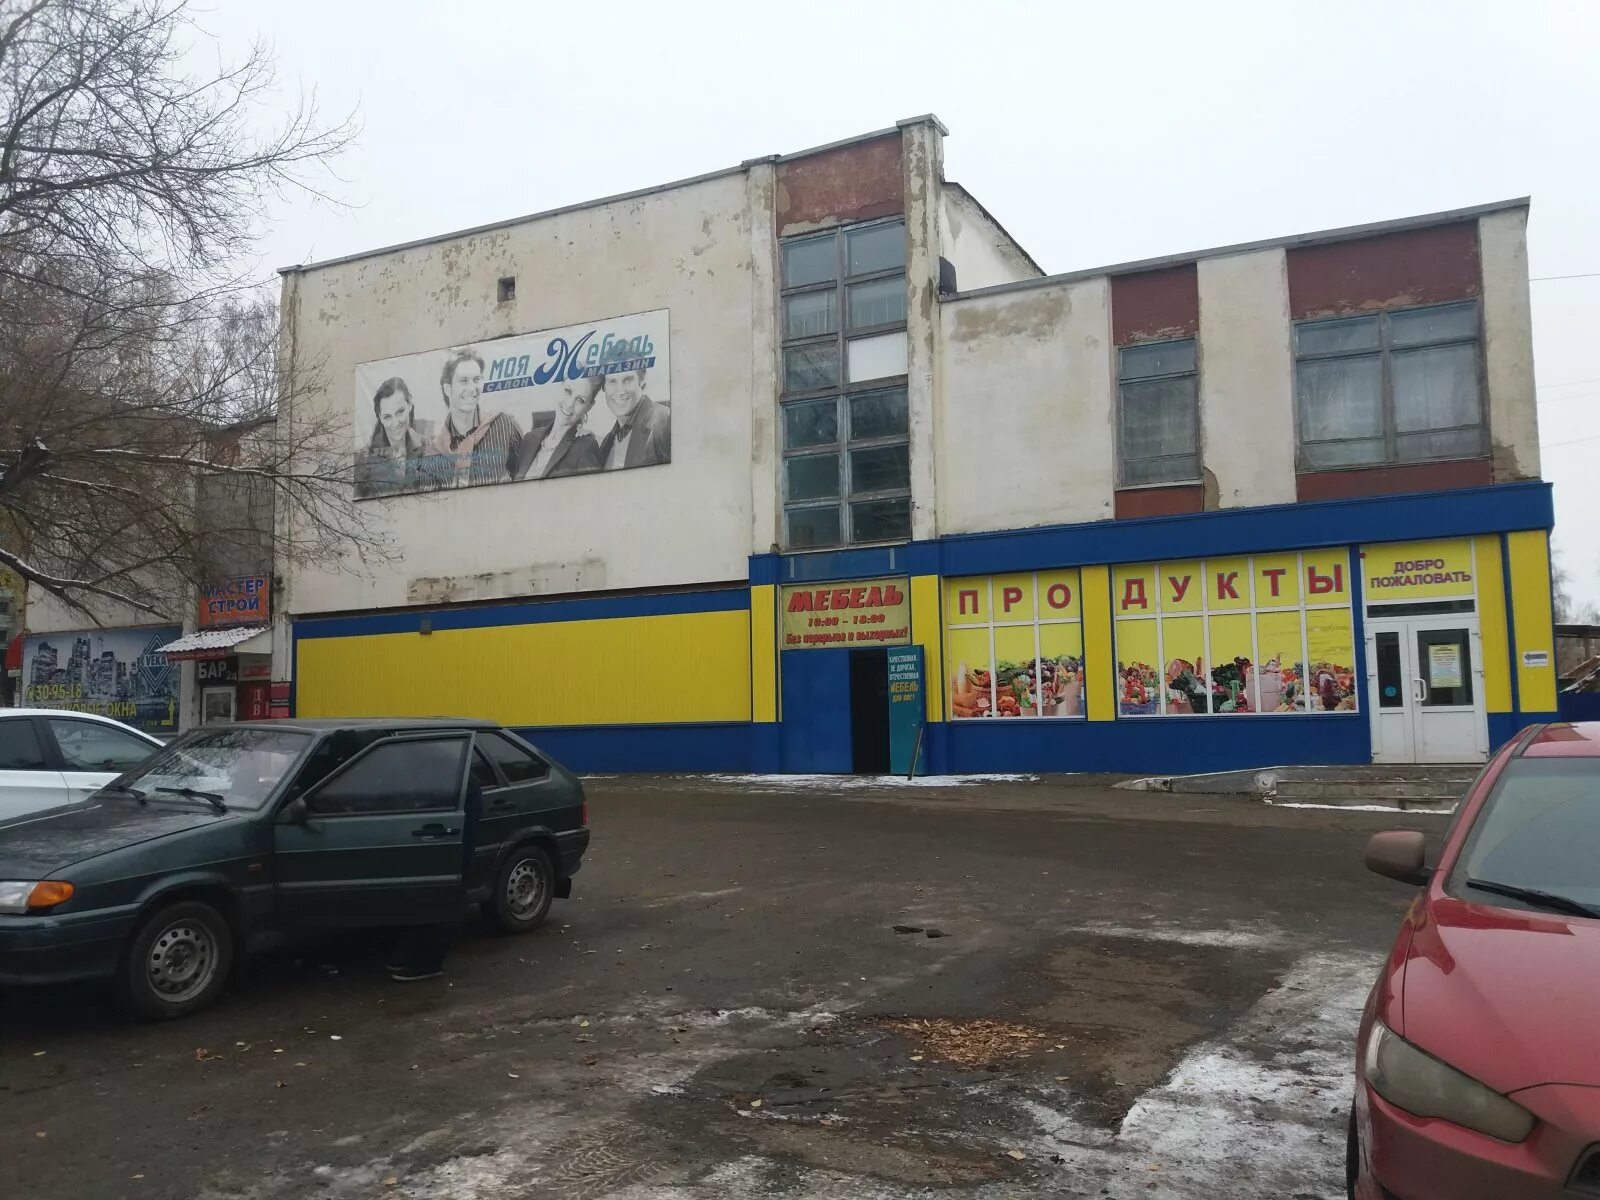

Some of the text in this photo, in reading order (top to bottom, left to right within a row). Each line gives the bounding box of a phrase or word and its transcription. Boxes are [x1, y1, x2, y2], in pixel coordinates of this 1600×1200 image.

[489, 330, 654, 386] МОЯ Мебель
[486, 358, 650, 393] САЛОН МАГАЗИН
[1394, 558, 1445, 574] ДОБРО
[1371, 570, 1472, 588] ПОЖАЛОВАТЬ
[208, 594, 259, 614] СТРОЙ
[787, 584, 904, 613] МЕБЕЛЬ
[144, 654, 167, 667] VEKA
[198, 660, 227, 680] БАР
[890, 681, 919, 693] МЕБЕЛЬ
[105, 702, 137, 718] ОКНА
